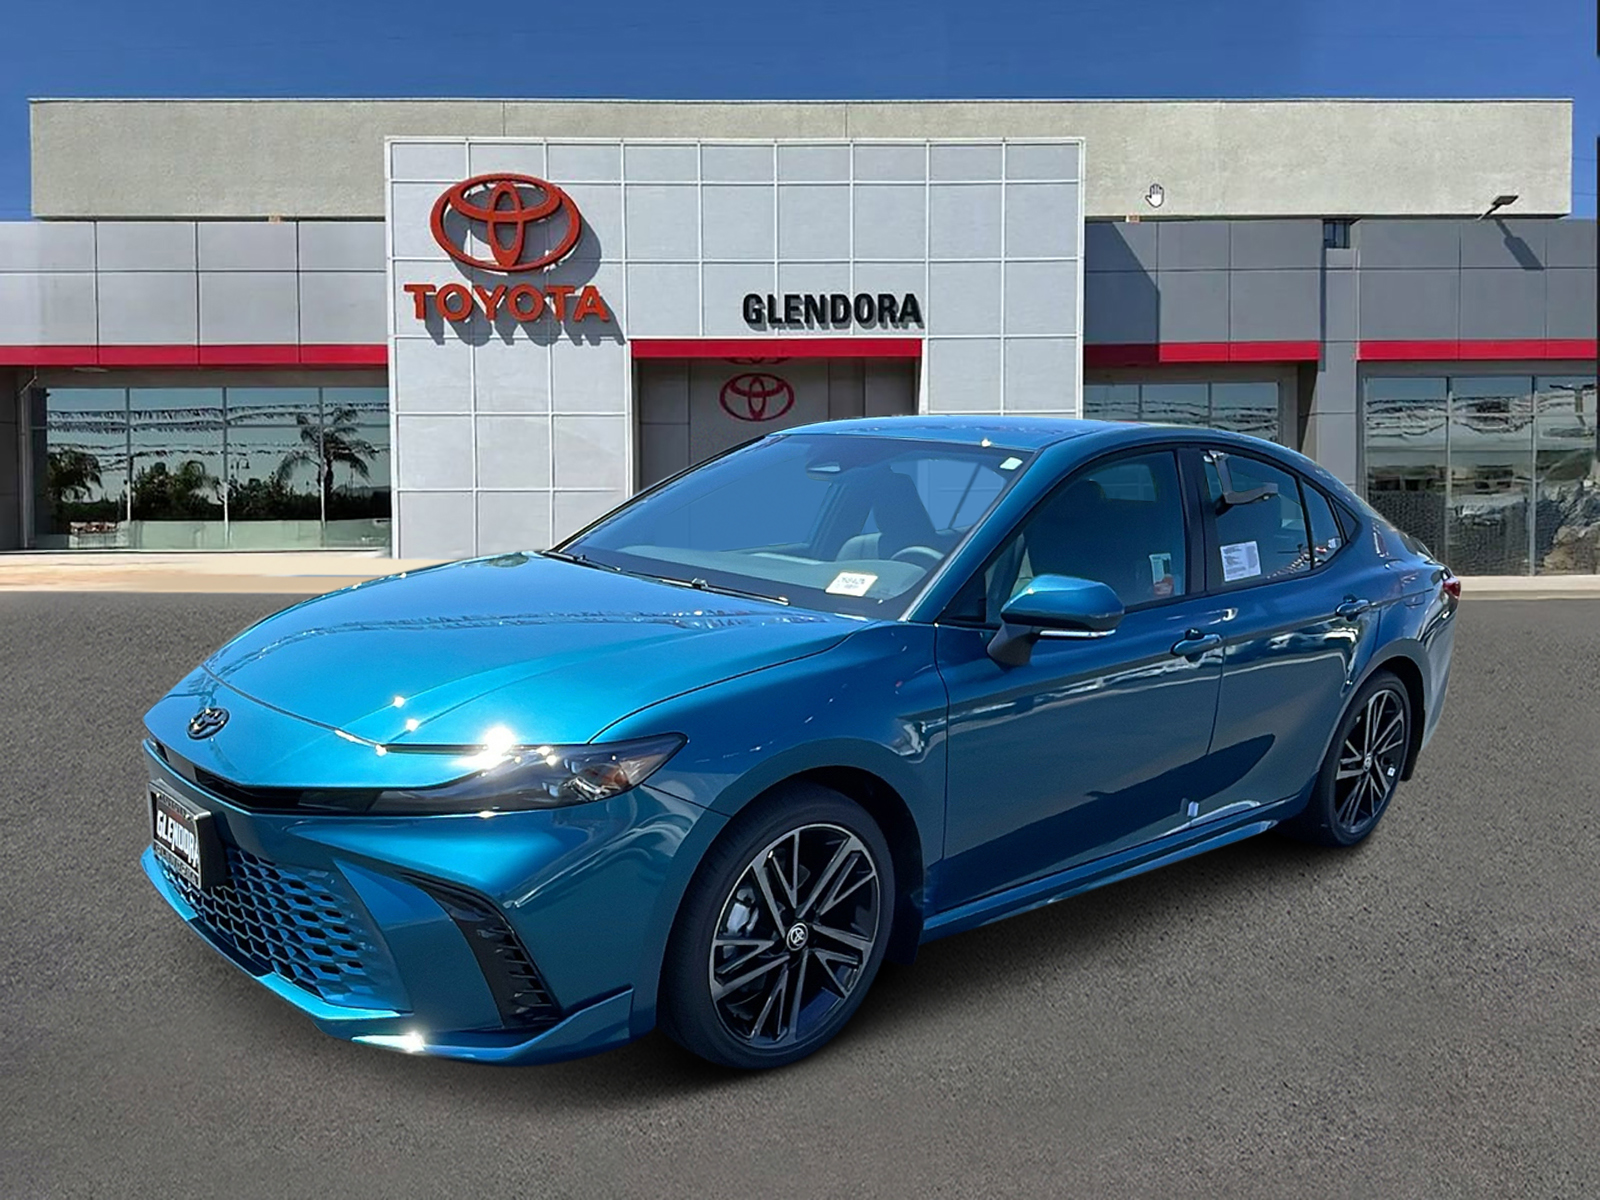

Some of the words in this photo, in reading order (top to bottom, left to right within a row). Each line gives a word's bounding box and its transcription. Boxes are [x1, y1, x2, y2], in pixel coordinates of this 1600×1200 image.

[404, 283, 610, 323] TOYOTA
[743, 293, 922, 324] GLENDORA
[156, 809, 199, 868] GLENDORA
